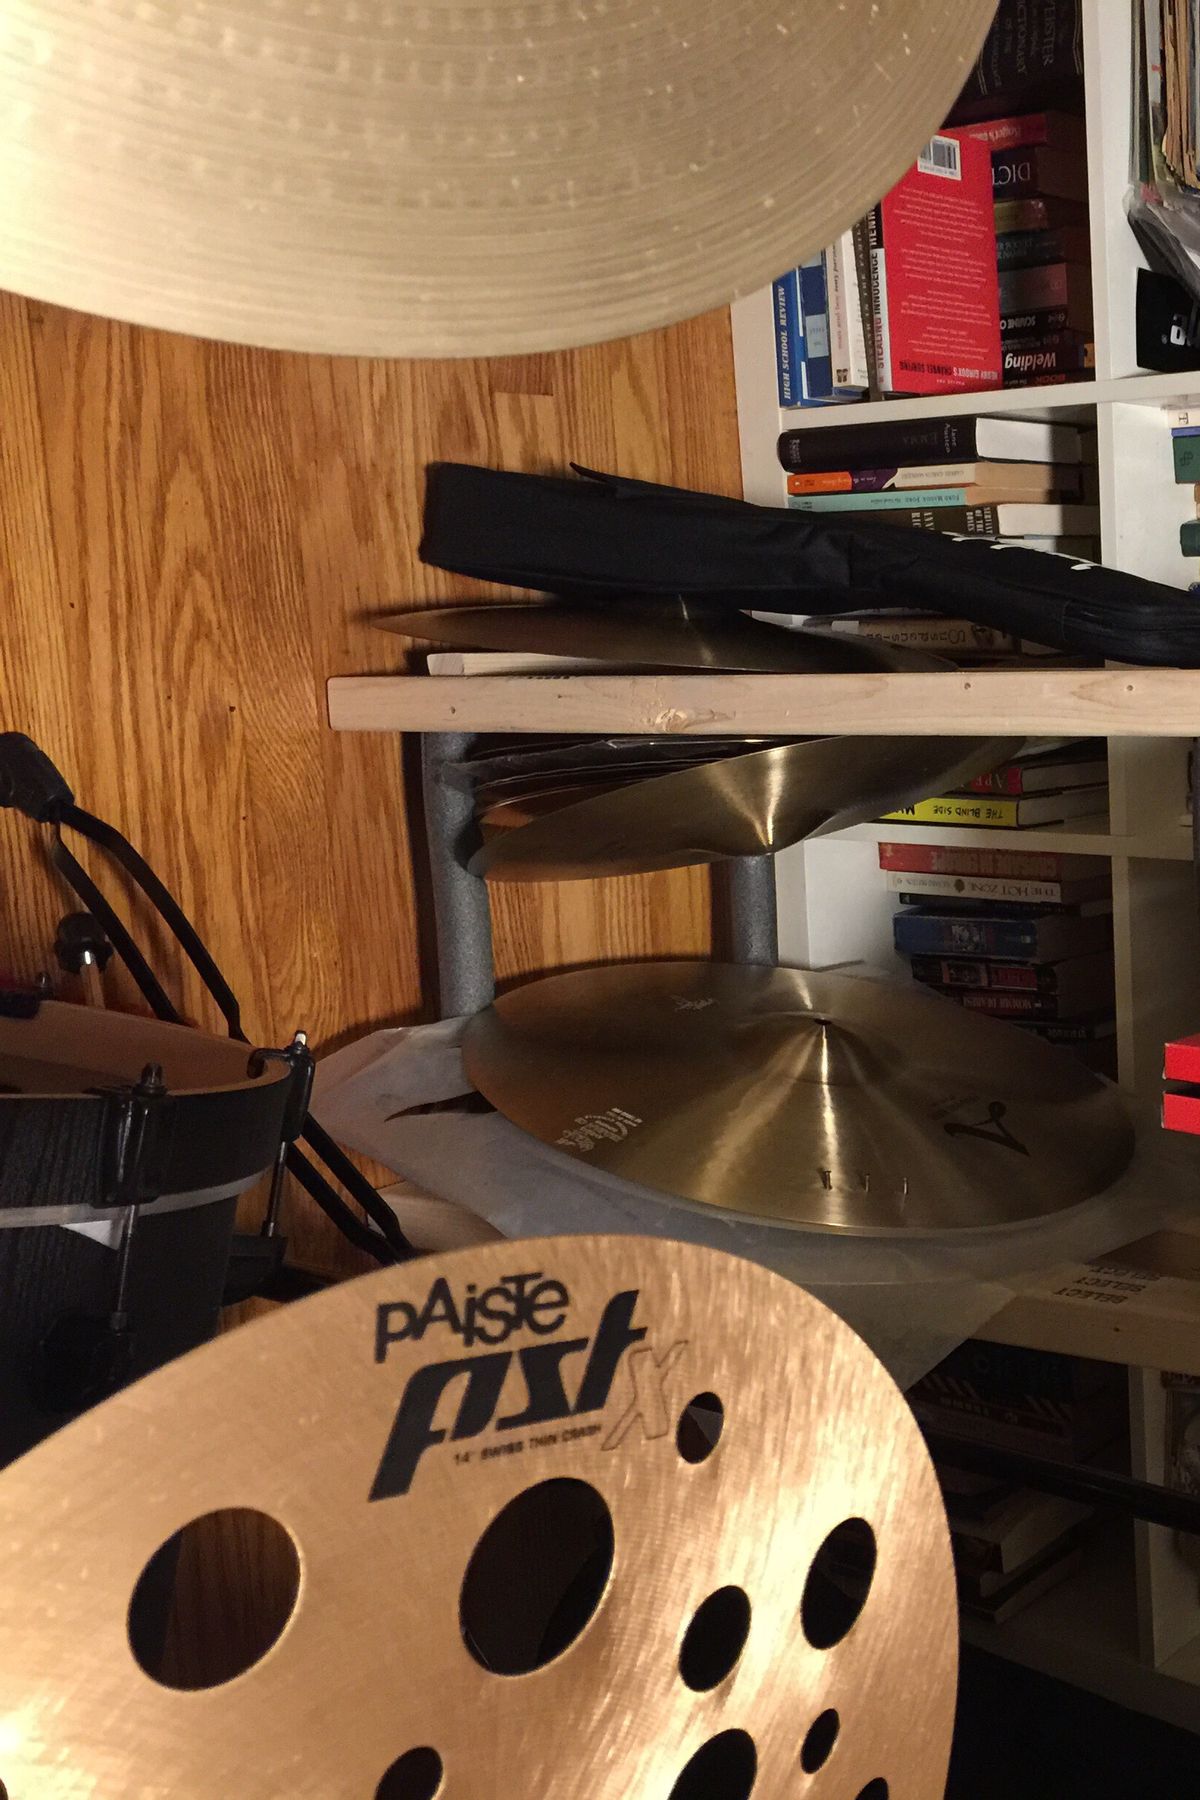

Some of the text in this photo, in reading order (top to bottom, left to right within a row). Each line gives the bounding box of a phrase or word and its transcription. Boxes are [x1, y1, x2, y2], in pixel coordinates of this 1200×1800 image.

[870, 252, 885, 370] STEALING INNOCENCE
[777, 286, 791, 400] HIGH SCHOOL REVIEW
[1004, 351, 1057, 370] Welding
[932, 805, 1004, 820] THE BLIND SIDE
[968, 882, 1056, 897] THE HOT ZONE
[1072, 1277, 1146, 1292] SELECT
[528, 1426, 601, 1450] THIN CRASH
